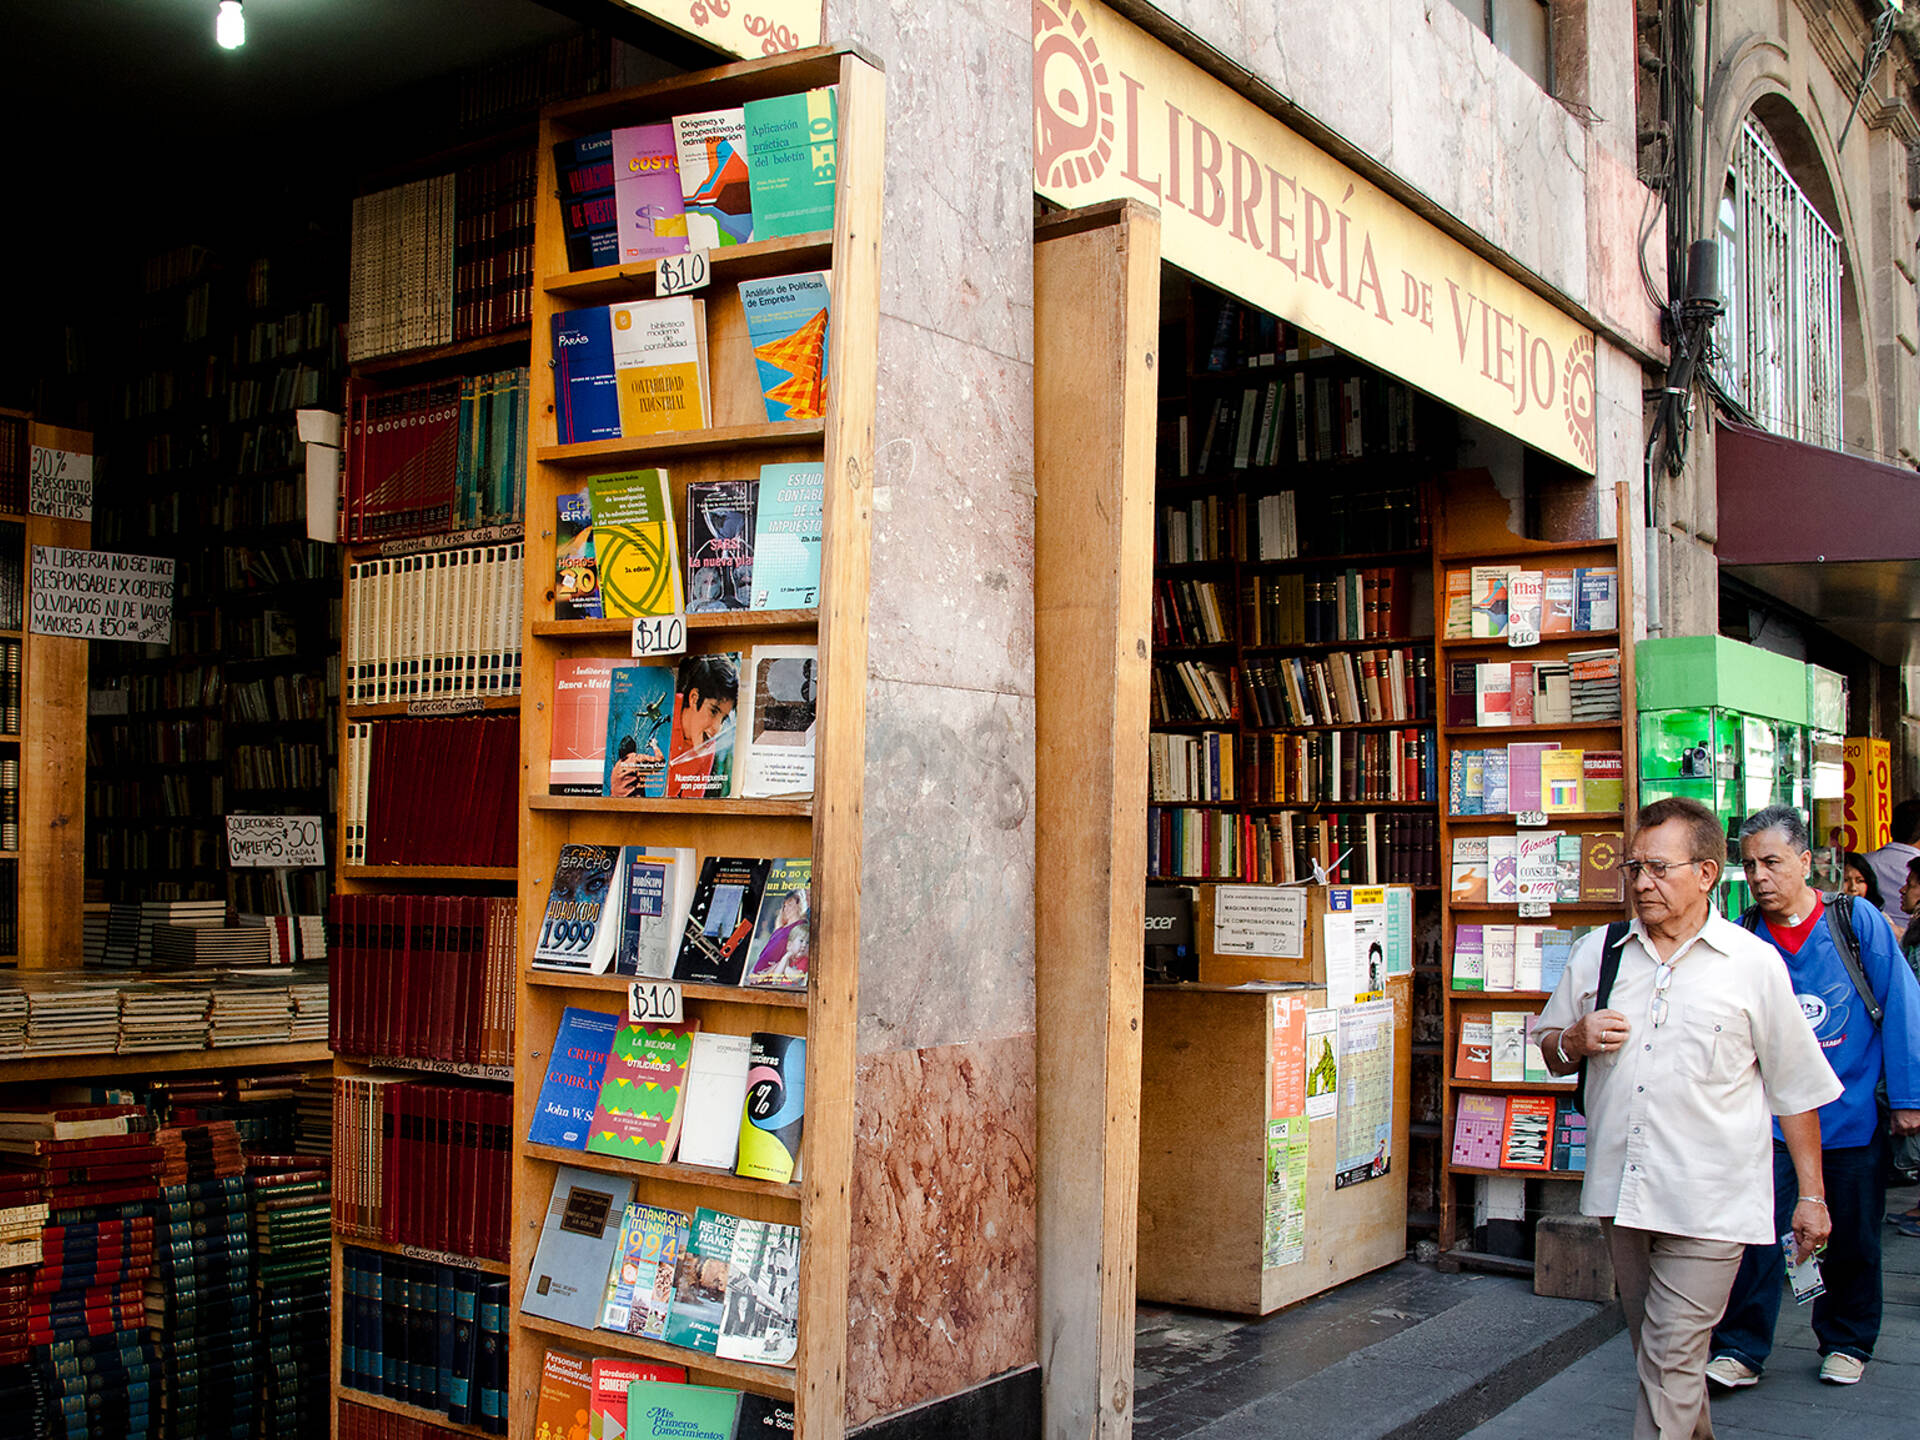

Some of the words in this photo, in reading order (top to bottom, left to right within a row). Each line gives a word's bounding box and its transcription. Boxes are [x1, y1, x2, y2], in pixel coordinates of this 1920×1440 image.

[681, 124, 735, 139] perspectivas
[752, 119, 799, 137] Aplicación
[753, 138, 790, 155] práctica
[755, 156, 769, 168] del
[773, 151, 805, 166] boletín
[1120, 71, 1394, 326] LIBRERÍA
[1401, 270, 1434, 334] DE
[1445, 277, 1556, 416] VIEJO
[660, 253, 705, 295] $10
[745, 286, 775, 299] Análisis
[776, 285, 788, 294] de
[788, 281, 823, 292] Políticas
[747, 299, 758, 308] de
[759, 294, 796, 306] Empresa
[647, 328, 680, 337] moderna
[650, 320, 685, 330] biblioteca
[643, 340, 688, 351] contabilidad
[631, 375, 684, 394] CONTABILIDAD
[639, 395, 687, 413] INDUSTRIAL
[31, 474, 43, 489] DE
[44, 476, 92, 493] DESCUENTO
[31, 500, 84, 519] COMPLETAS
[793, 503, 806, 517] DE
[441, 531, 466, 545] Pesos
[470, 527, 493, 541] Cada
[33, 546, 49, 566] LA
[53, 548, 110, 571] LIBRERIA
[111, 554, 129, 572] NO
[129, 556, 148, 573] SE
[150, 559, 174, 576] HACE
[703, 557, 733, 568] nueva
[33, 568, 117, 595] RESPONSABLE
[119, 578, 130, 596] X
[131, 579, 175, 600] OBJETOS
[33, 592, 101, 616] OLVIDADOS
[105, 600, 120, 617] NI
[122, 601, 137, 619] DE
[140, 602, 173, 623] VALOR
[34, 614, 83, 634] MAYORES
[85, 619, 96, 636] A
[637, 618, 683, 653] $10
[1510, 632, 1535, 645] $10
[616, 671, 629, 680] Play
[674, 773, 701, 783] Nuestros
[701, 773, 729, 783] impuestos
[1877, 760, 1890, 848] ORO
[227, 817, 286, 831] COLECCIONES
[1519, 811, 1544, 824] $10
[229, 836, 284, 861] COMPLETAS
[560, 856, 613, 871] BRACHO
[767, 882, 780, 890] un
[547, 900, 600, 923] HOROSCOPO
[1144, 916, 1177, 930] acer
[539, 919, 596, 953] 1999
[632, 985, 677, 1019] $10
[632, 1037, 642, 1047] LA
[644, 1039, 677, 1051] MEJORA
[646, 1050, 656, 1059] de
[371, 1055, 419, 1070] Enciclopedia
[431, 1060, 455, 1074] Pesos
[456, 1061, 480, 1075] Cada
[483, 1064, 511, 1078] Tomo
[588, 1063, 597, 1076] Y
[627, 1059, 672, 1073] UTILIDADES
[544, 1102, 570, 1118] John
[624, 1204, 688, 1229] ALMANAQUE
[630, 1218, 677, 1238] MUNDIAL
[618, 1228, 678, 1262] 1994
[440, 1251, 480, 1269] Completa
[545, 1351, 584, 1370] Personnel
[599, 1368, 640, 1380] Introducción
[645, 1406, 675, 1420] Mis
[763, 1416, 774, 1426] de
[653, 1415, 699, 1430] Primeros
[651, 1424, 725, 1440] Conocimientos
